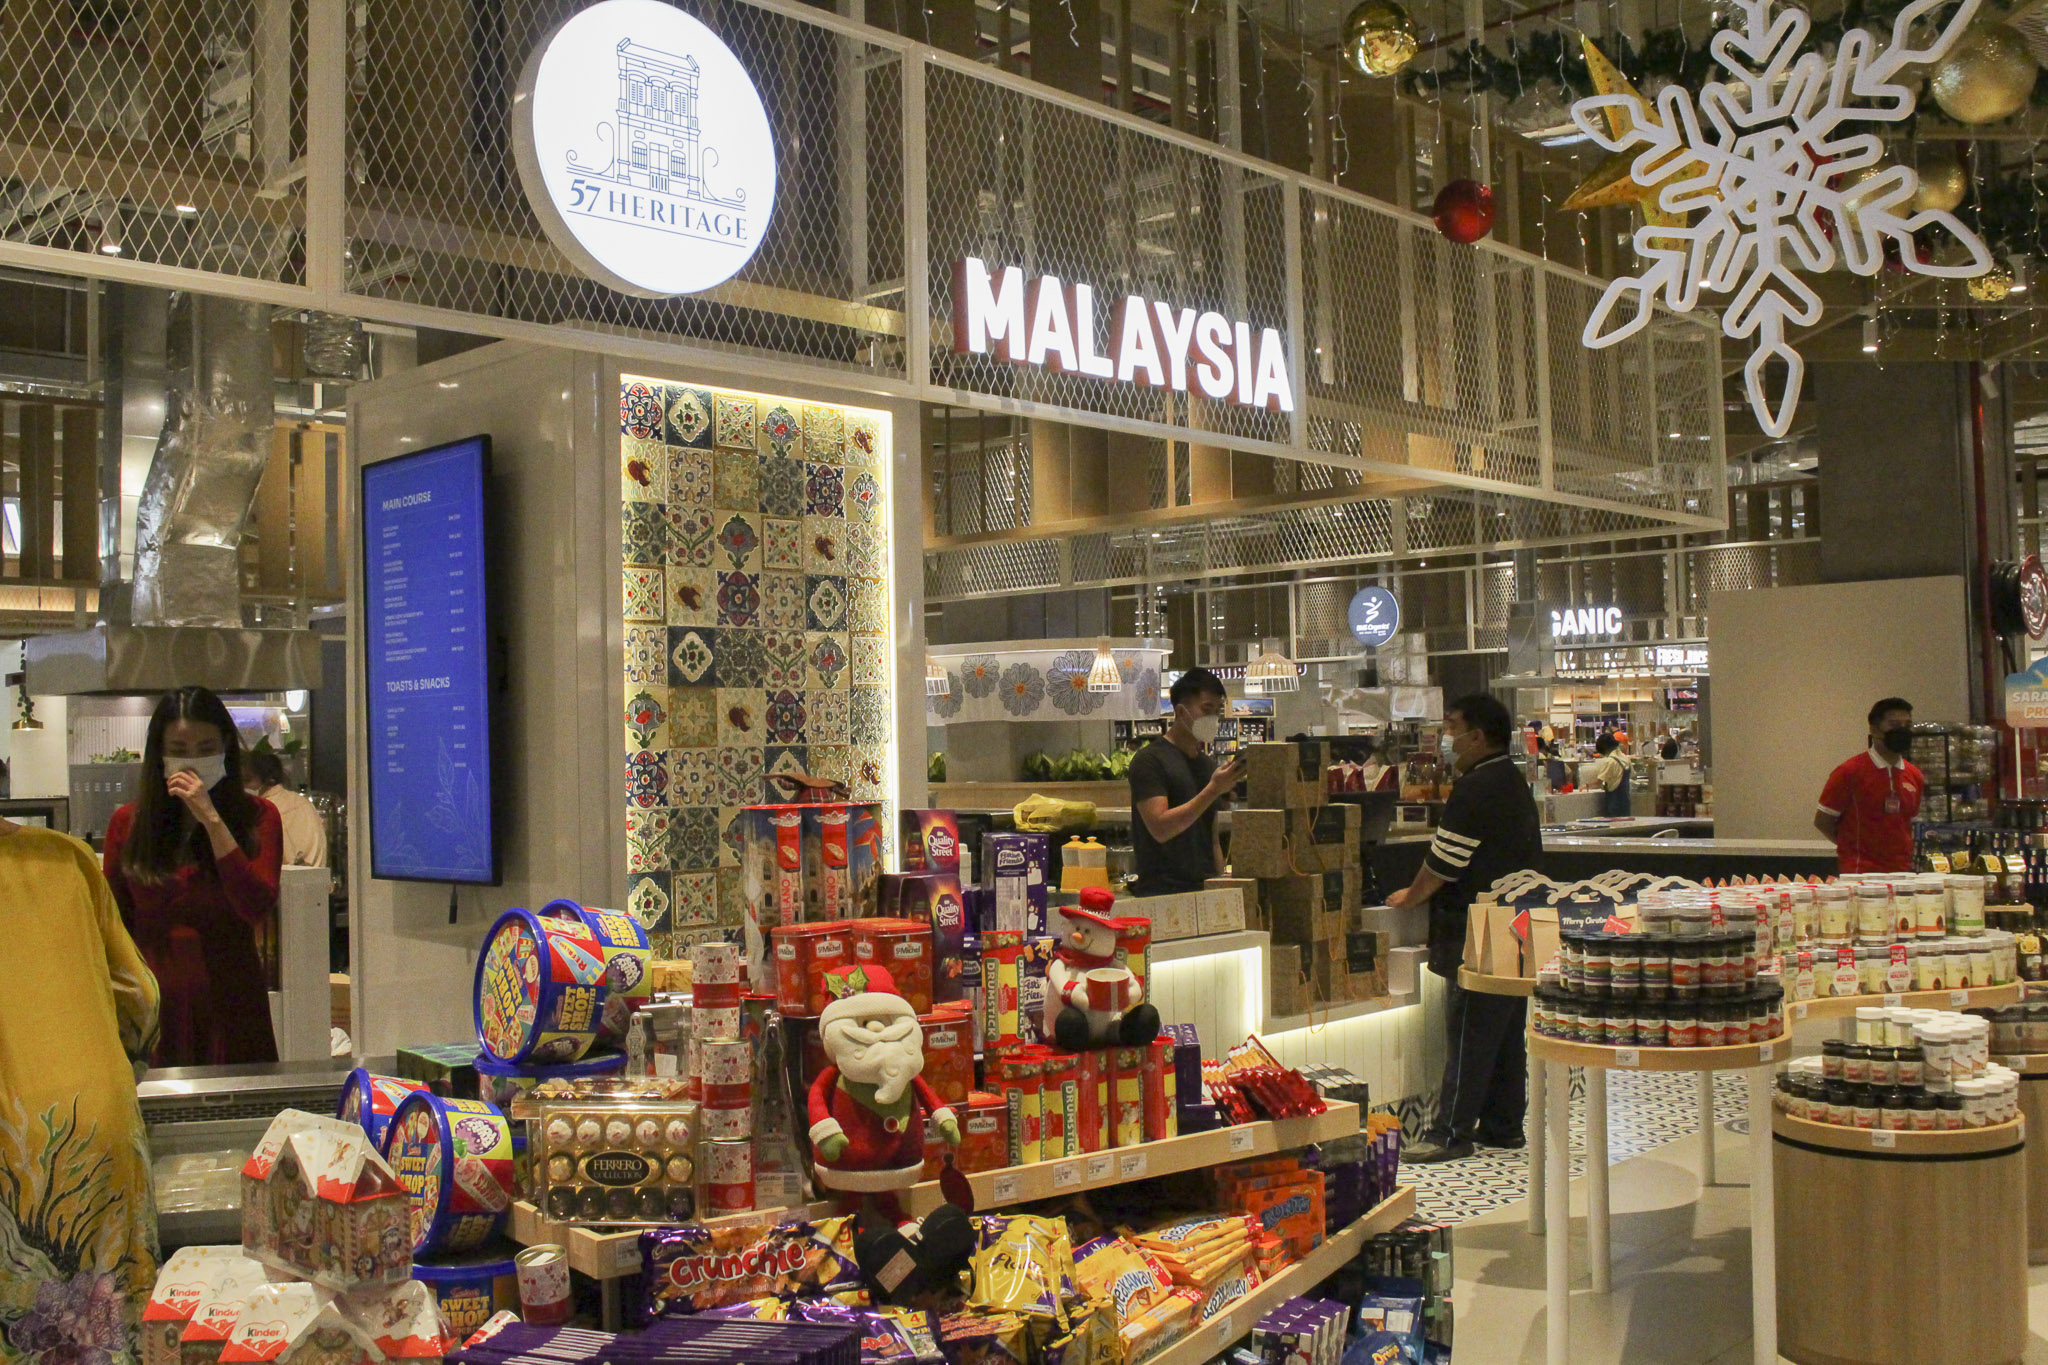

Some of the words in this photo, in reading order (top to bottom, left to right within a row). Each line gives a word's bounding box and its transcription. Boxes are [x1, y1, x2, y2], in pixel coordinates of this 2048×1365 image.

[569, 178, 602, 212] 57
[608, 190, 748, 240] HERITAGE
[966, 256, 1295, 412] MALAYSIA
[382, 498, 402, 512] MAIN
[402, 490, 432, 508] COURSE
[386, 680, 413, 692] TOASTS
[413, 679, 419, 691] &
[419, 676, 451, 691] SNACKS
[928, 834, 955, 848] Quality
[931, 847, 954, 857] Street
[781, 879, 794, 924] MILANO
[825, 875, 836, 921] MILANO
[935, 902, 960, 917] Quality
[939, 916, 959, 927] Street
[1562, 916, 1584, 928] Merry
[558, 986, 577, 1031] SWEET
[986, 962, 996, 1036] DRUMSTICK
[570, 987, 590, 1031] SHOP
[401, 1156, 427, 1172] SWEET
[593, 1159, 643, 1171] FERRERO
[669, 1241, 807, 1288] Crunchie
[441, 1296, 490, 1312] SWEET
